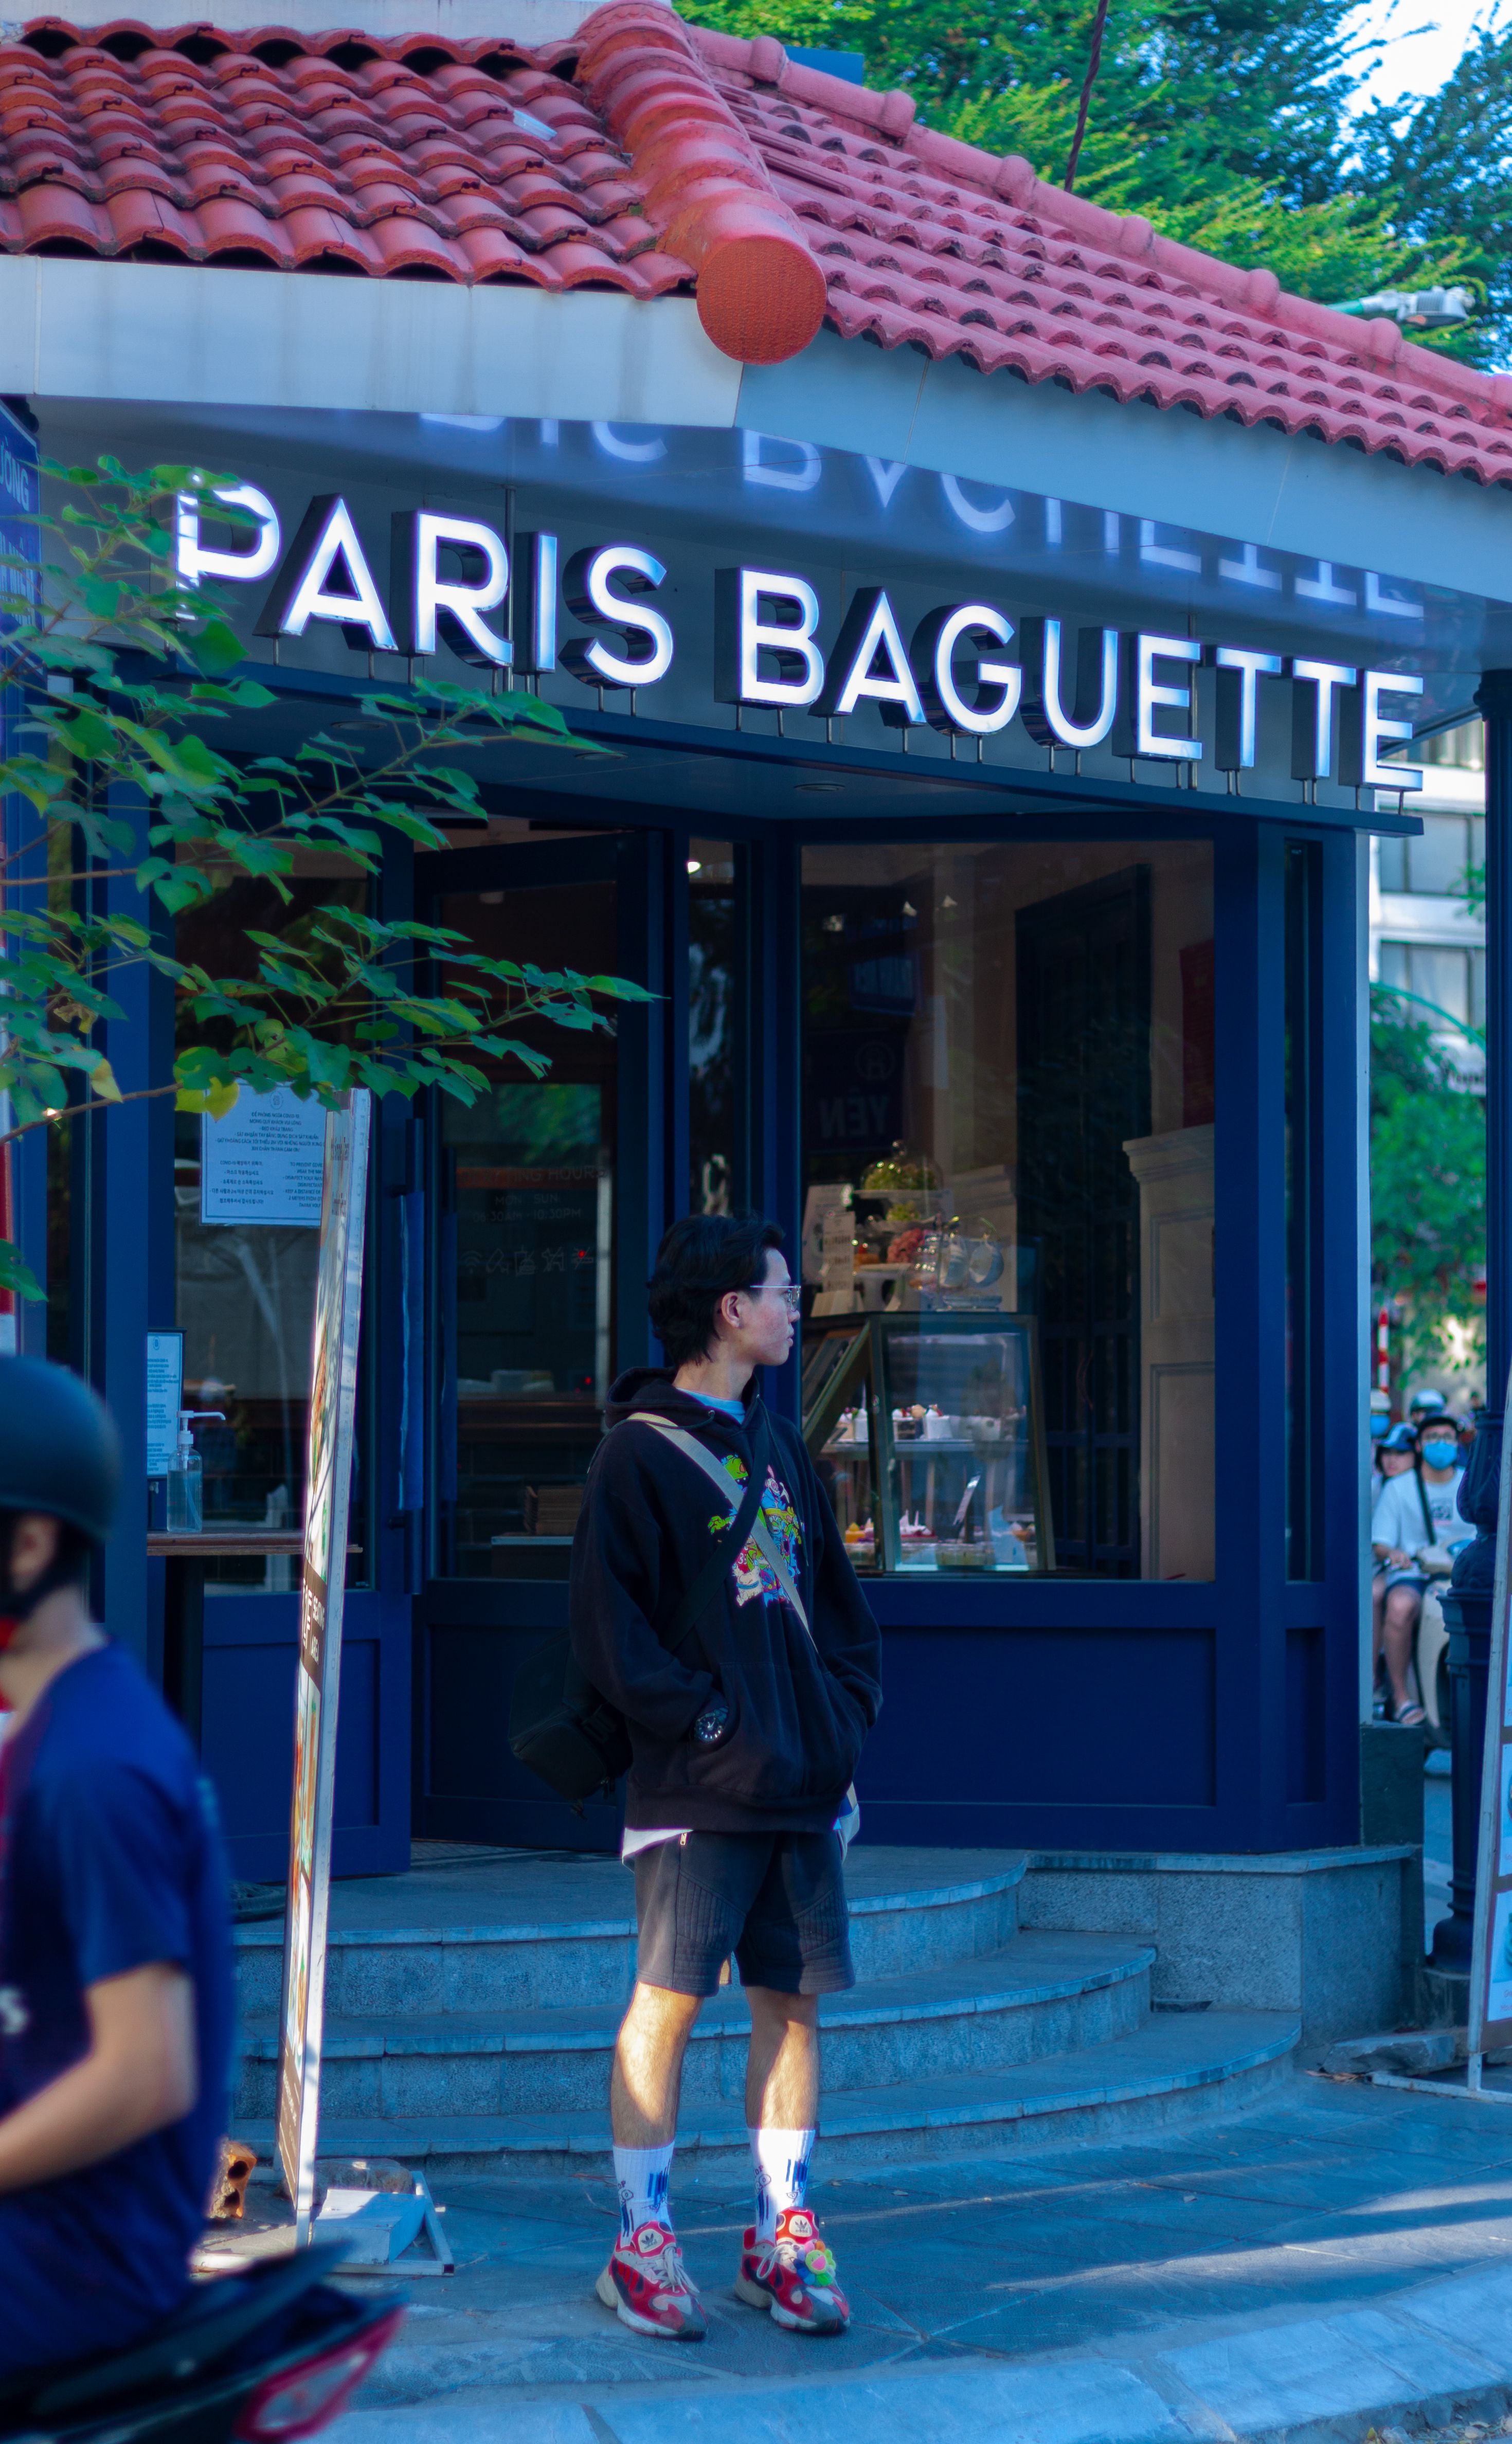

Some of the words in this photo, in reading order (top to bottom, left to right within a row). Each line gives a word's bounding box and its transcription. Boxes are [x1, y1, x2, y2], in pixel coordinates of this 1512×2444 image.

[176, 482, 675, 689] PARIS
[739, 568, 1424, 792] BAGUETTE
[495, 1195, 522, 1206] MON
[533, 1193, 559, 1205] SUN
